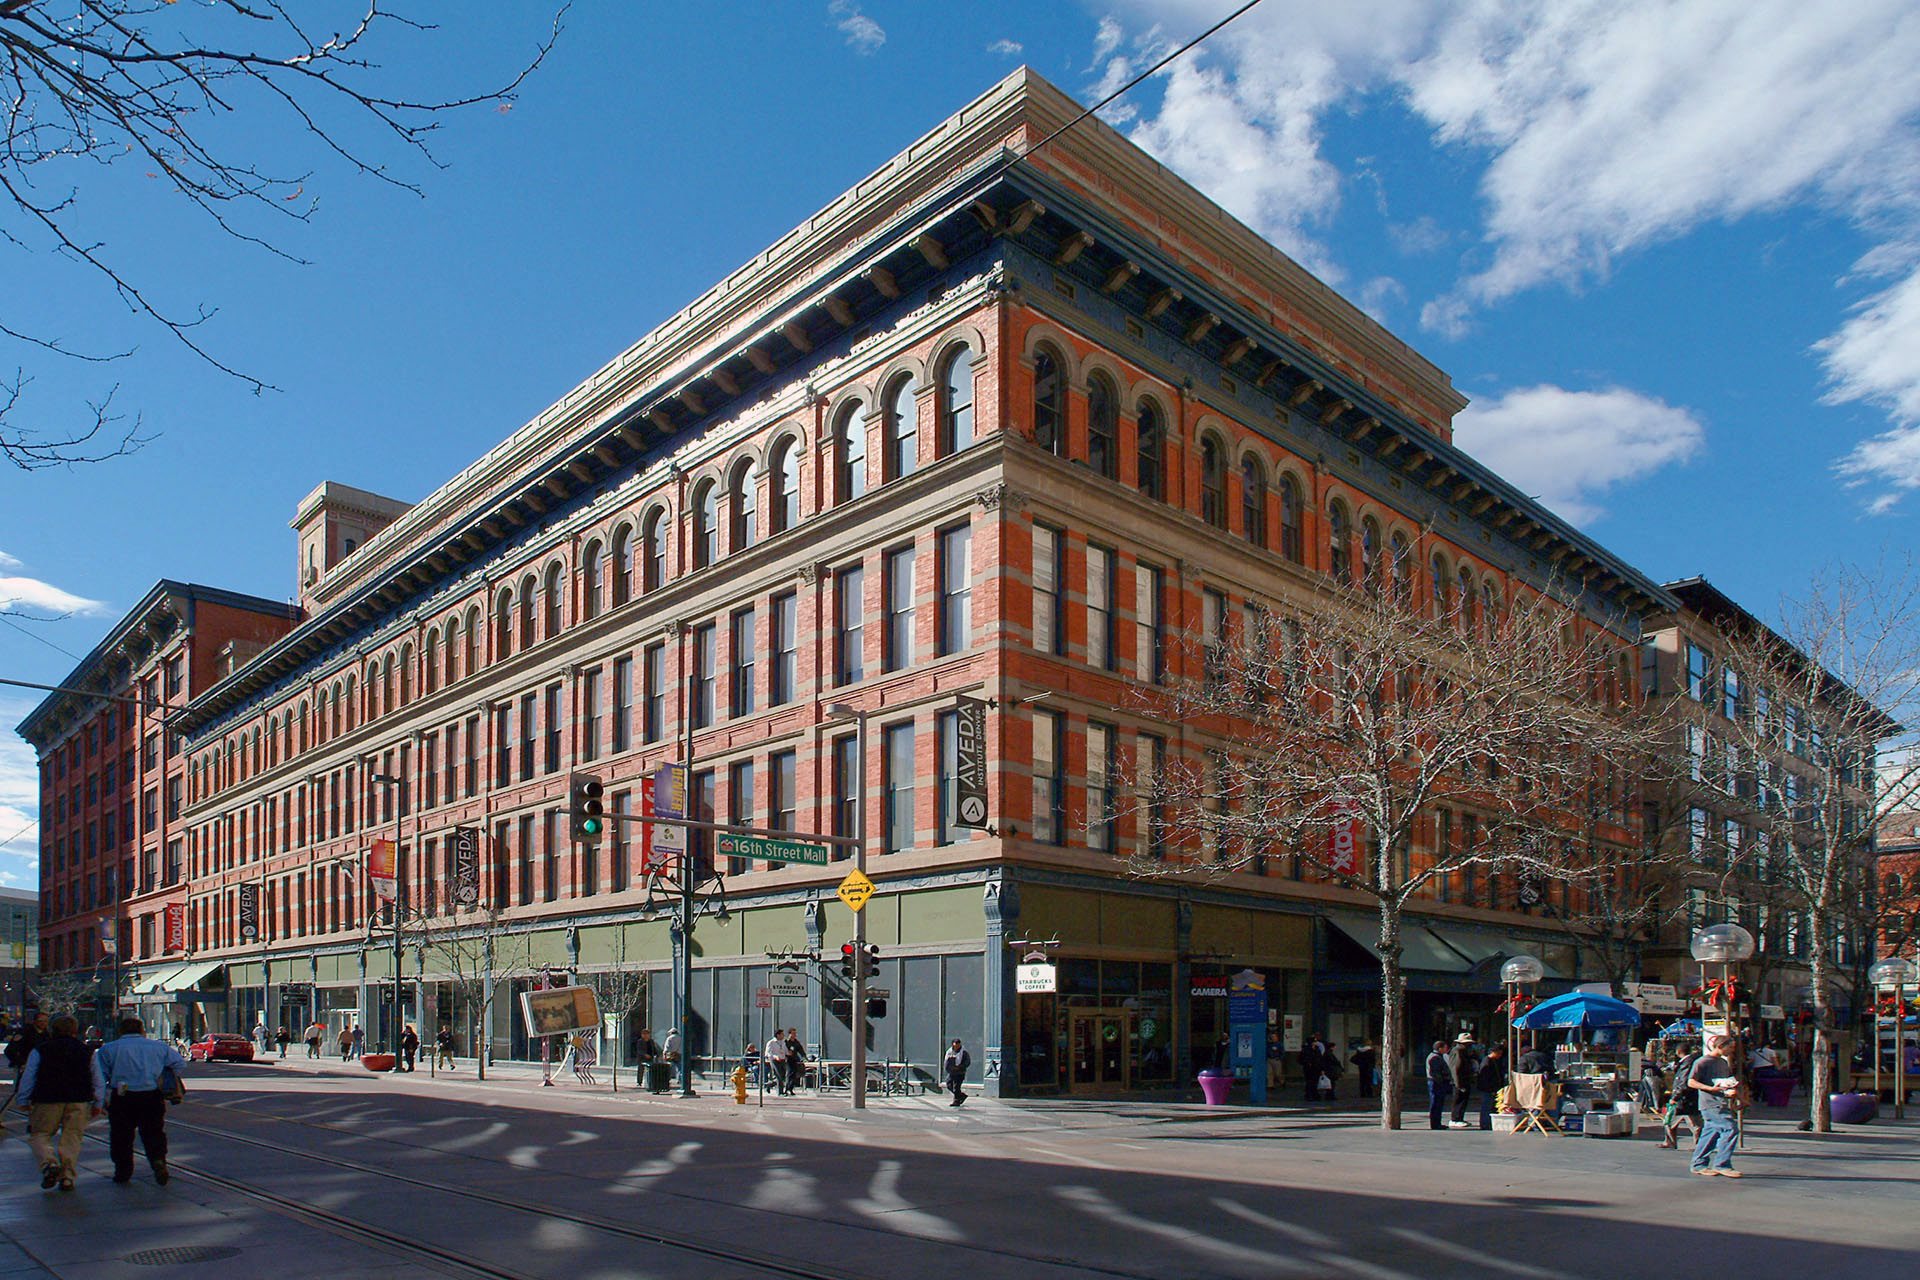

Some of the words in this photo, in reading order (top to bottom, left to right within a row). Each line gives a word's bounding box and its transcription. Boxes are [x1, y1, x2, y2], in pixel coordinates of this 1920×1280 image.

[958, 703, 976, 789] AVEDA
[976, 744, 984, 786] INSTITUTE
[671, 768, 683, 811] DENVER
[458, 830, 472, 882] AVEDA
[734, 839, 762, 855] 16th
[765, 843, 801, 860] Street
[803, 848, 825, 862] Mall
[241, 885, 252, 923] AVEDA
[1191, 988, 1228, 996] CAMERA
